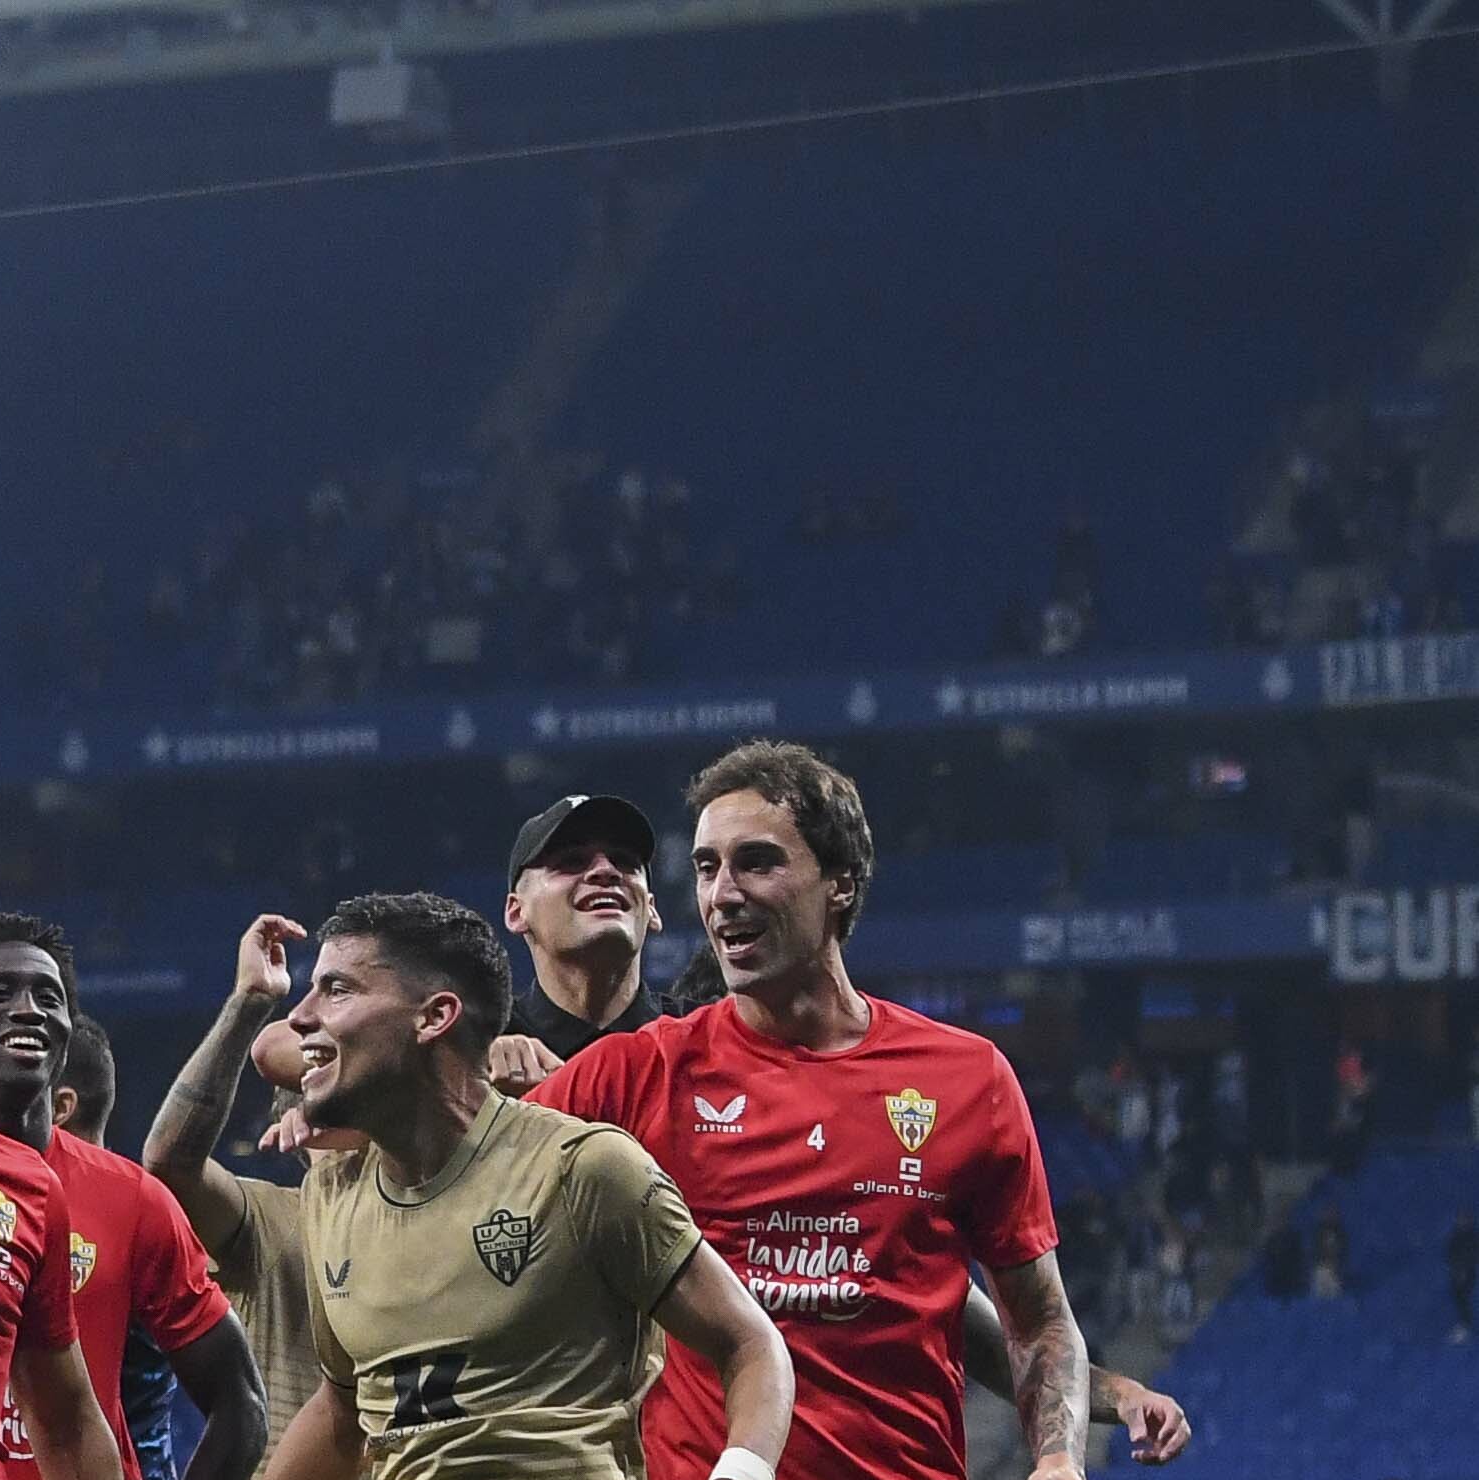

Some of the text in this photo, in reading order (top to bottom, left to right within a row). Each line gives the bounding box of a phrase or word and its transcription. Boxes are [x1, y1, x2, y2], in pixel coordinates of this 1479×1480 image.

[694, 1123, 744, 1133] CASTORE
[806, 1123, 826, 1151] 4
[853, 1180, 899, 1195] ajlan
[480, 1222, 523, 1239] U D
[746, 1211, 859, 1233] En Almería
[483, 1239, 526, 1251] ALMERIA
[773, 1235, 847, 1279] vida
[852, 1248, 871, 1274] te
